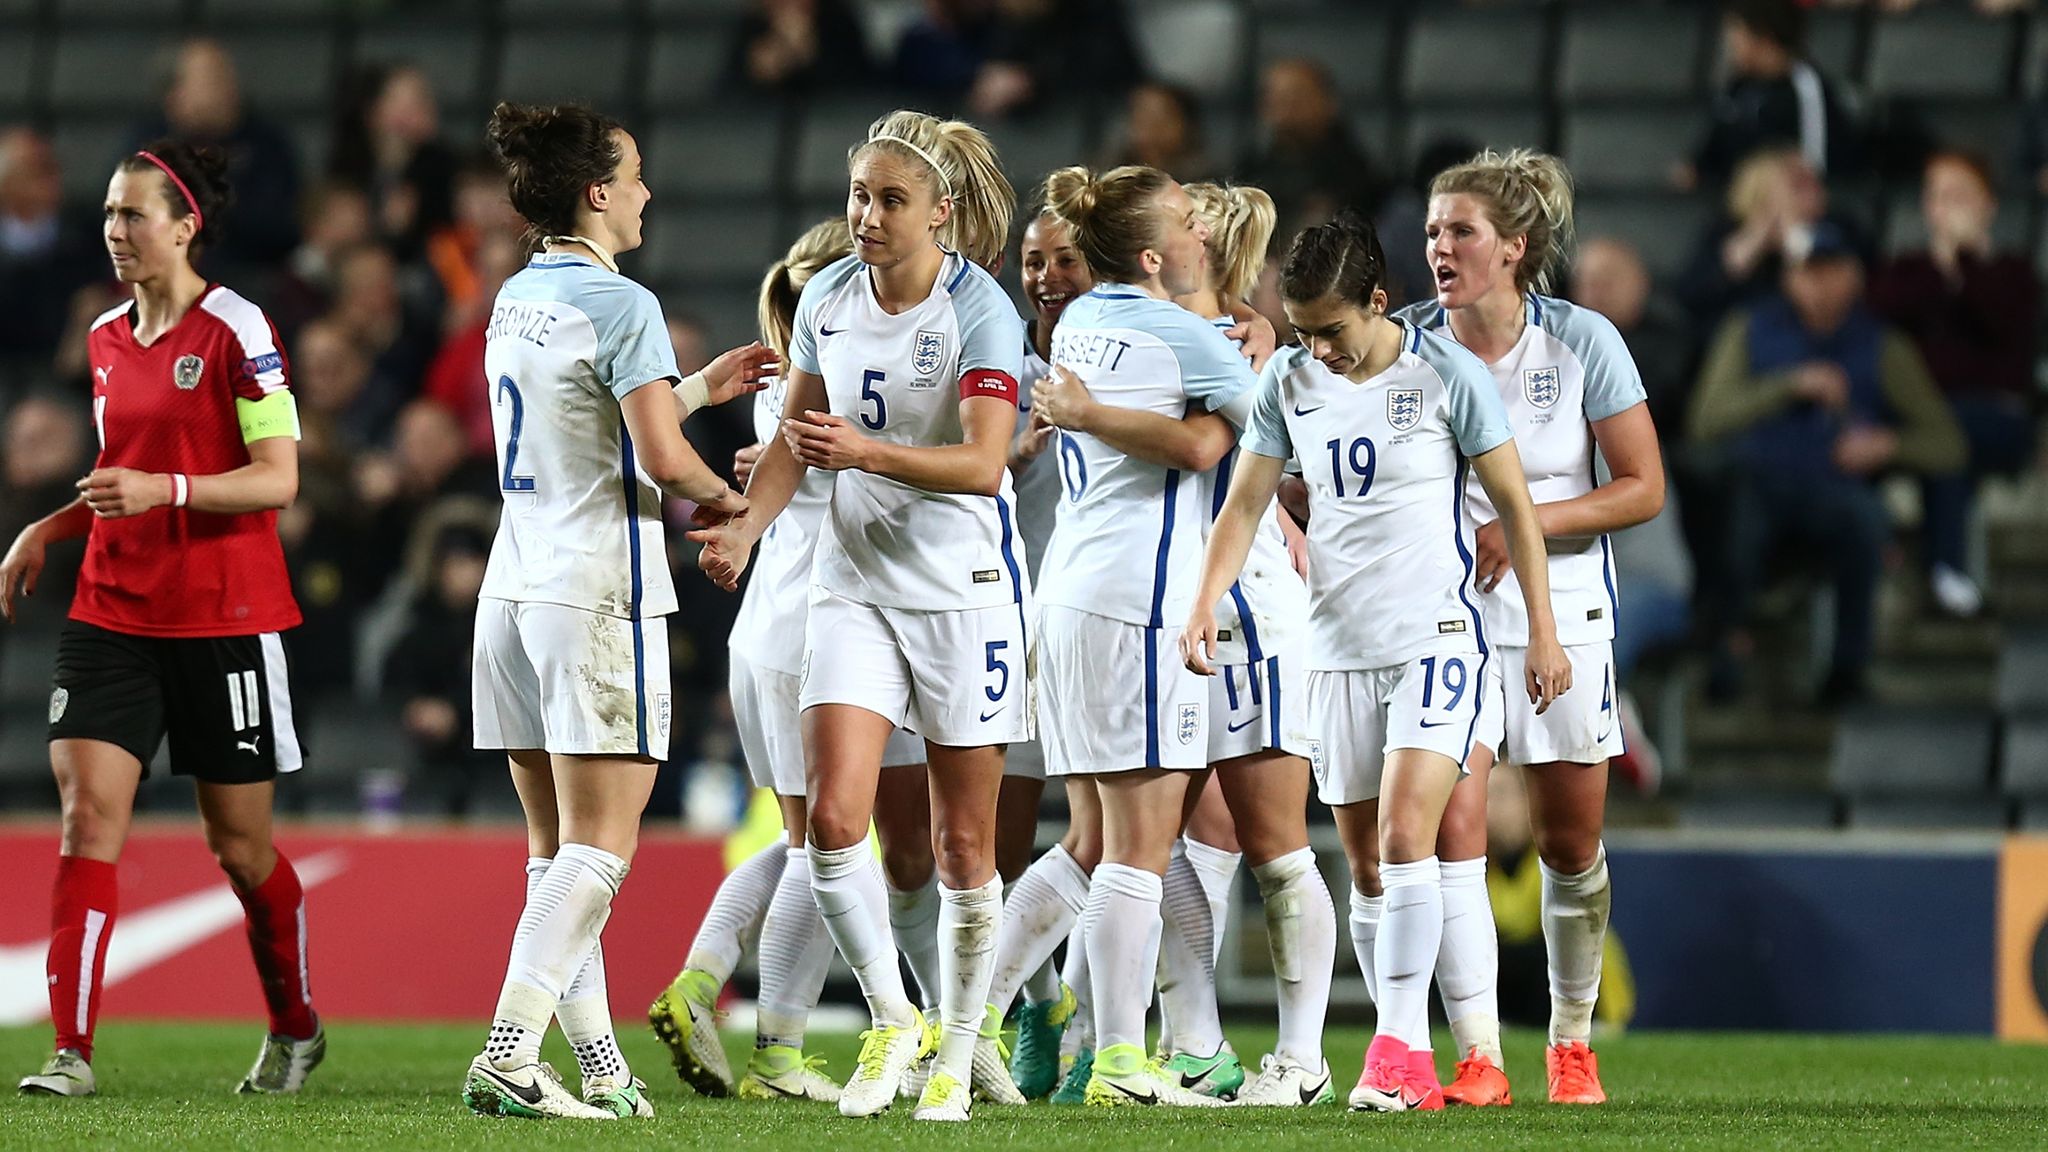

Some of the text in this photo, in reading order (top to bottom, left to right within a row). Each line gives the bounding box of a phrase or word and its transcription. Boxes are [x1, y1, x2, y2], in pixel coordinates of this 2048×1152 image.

[860, 369, 886, 430] 5
[498, 373, 537, 493] 2
[1327, 436, 1376, 497] 19
[227, 669, 260, 731] 11
[985, 640, 1009, 702] 5
[1420, 656, 1467, 711] 19
[1601, 662, 1611, 720] 4
